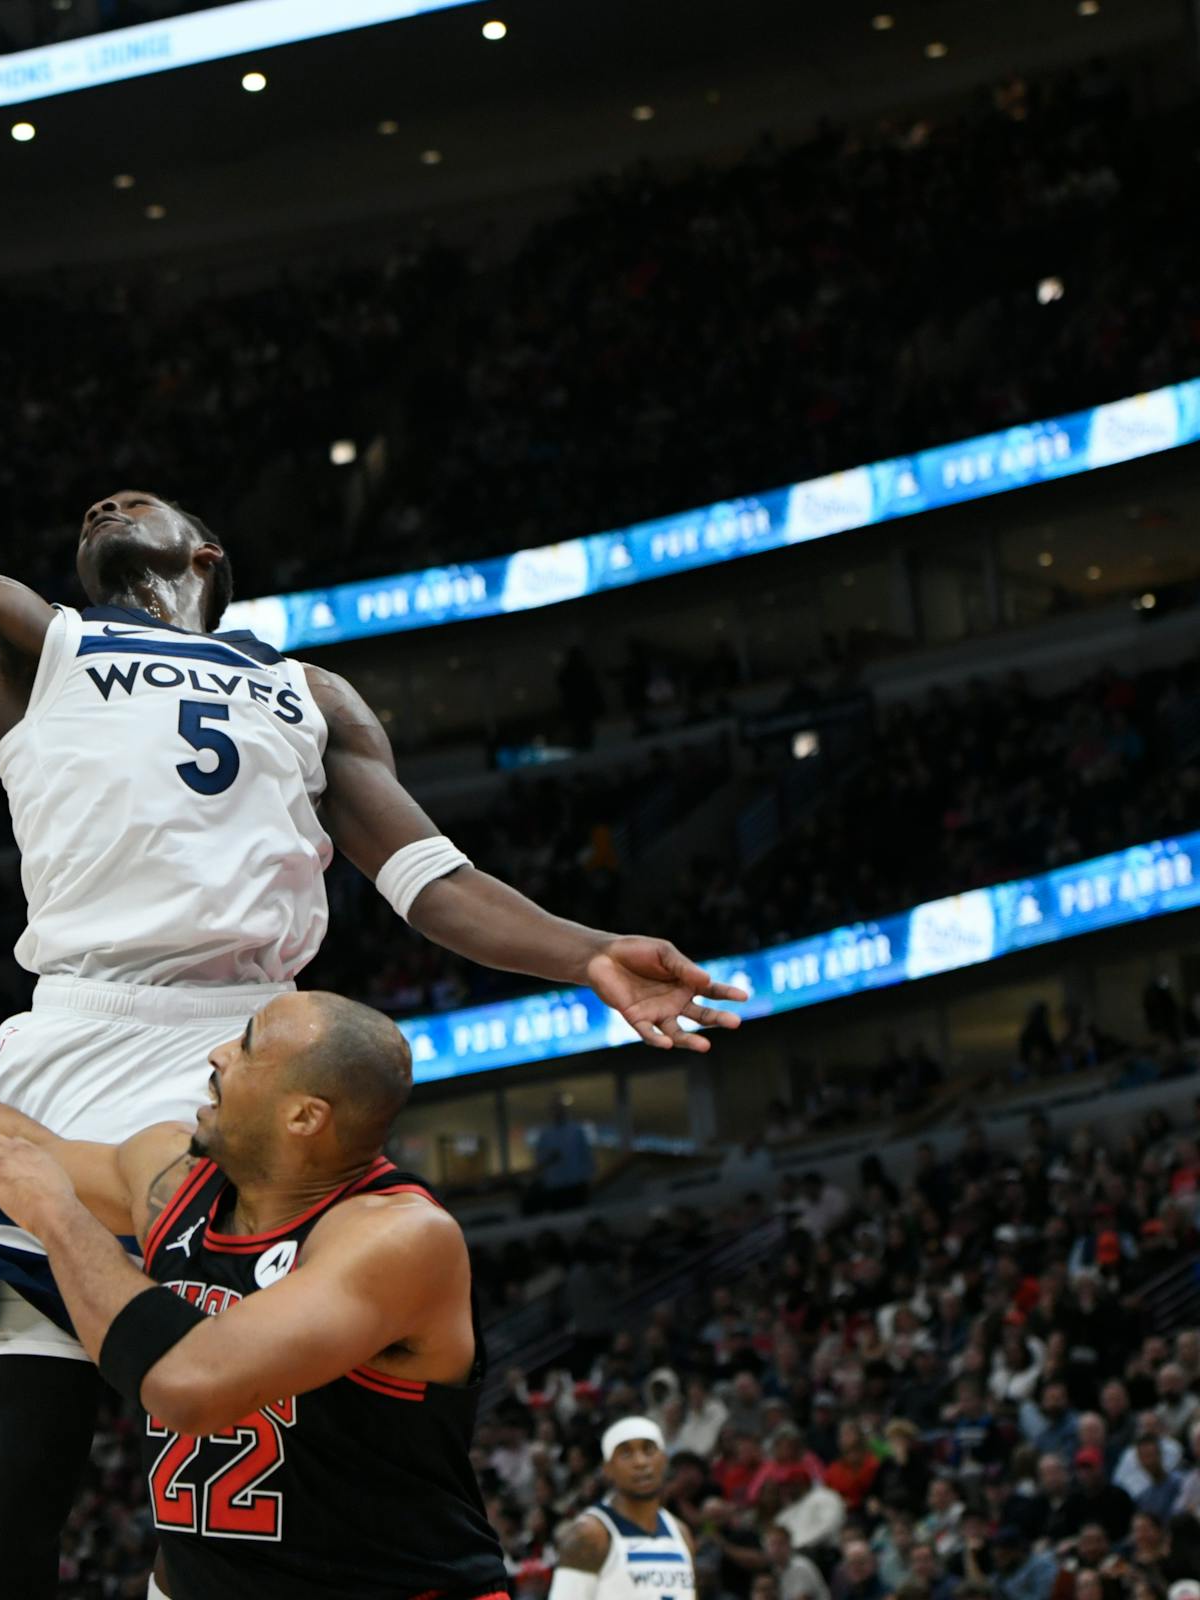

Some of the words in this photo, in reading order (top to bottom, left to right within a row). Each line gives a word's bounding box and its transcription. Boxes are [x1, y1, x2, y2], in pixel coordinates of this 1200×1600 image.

[85, 661, 304, 725] WOLVES
[176, 699, 241, 796] 5
[146, 1400, 285, 1543] 22
